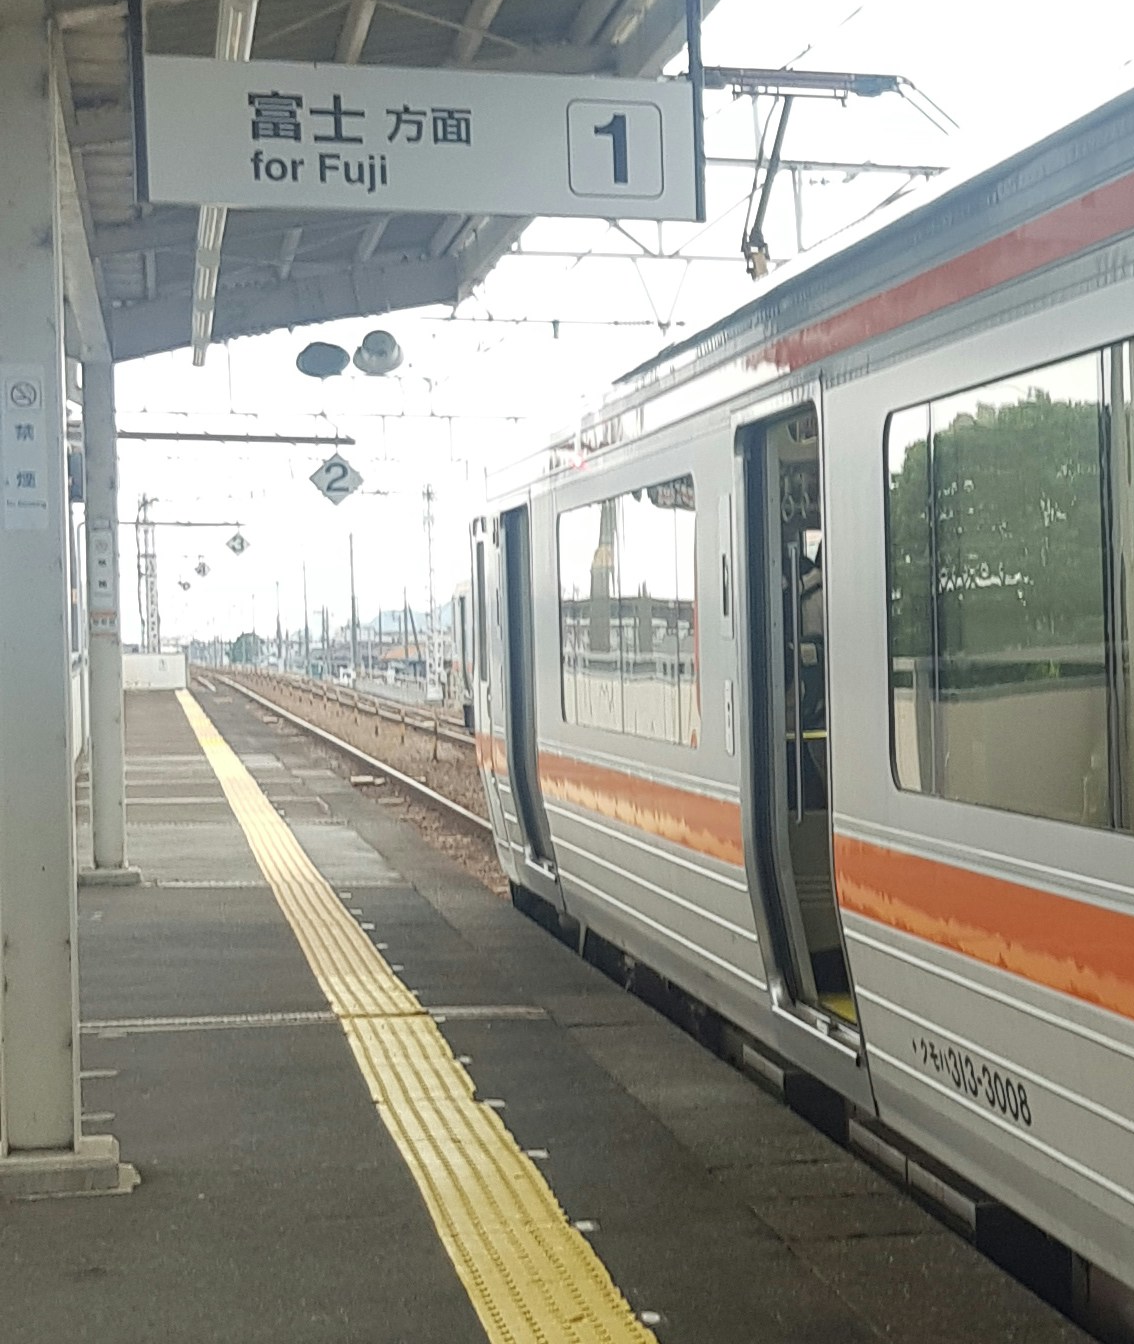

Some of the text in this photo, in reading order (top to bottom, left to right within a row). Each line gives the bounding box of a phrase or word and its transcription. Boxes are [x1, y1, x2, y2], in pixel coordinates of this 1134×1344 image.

[247, 91, 472, 146] 富士 方面
[251, 150, 388, 193] for Fuji
[593, 113, 628, 184] 1
[324, 462, 350, 492] 2
